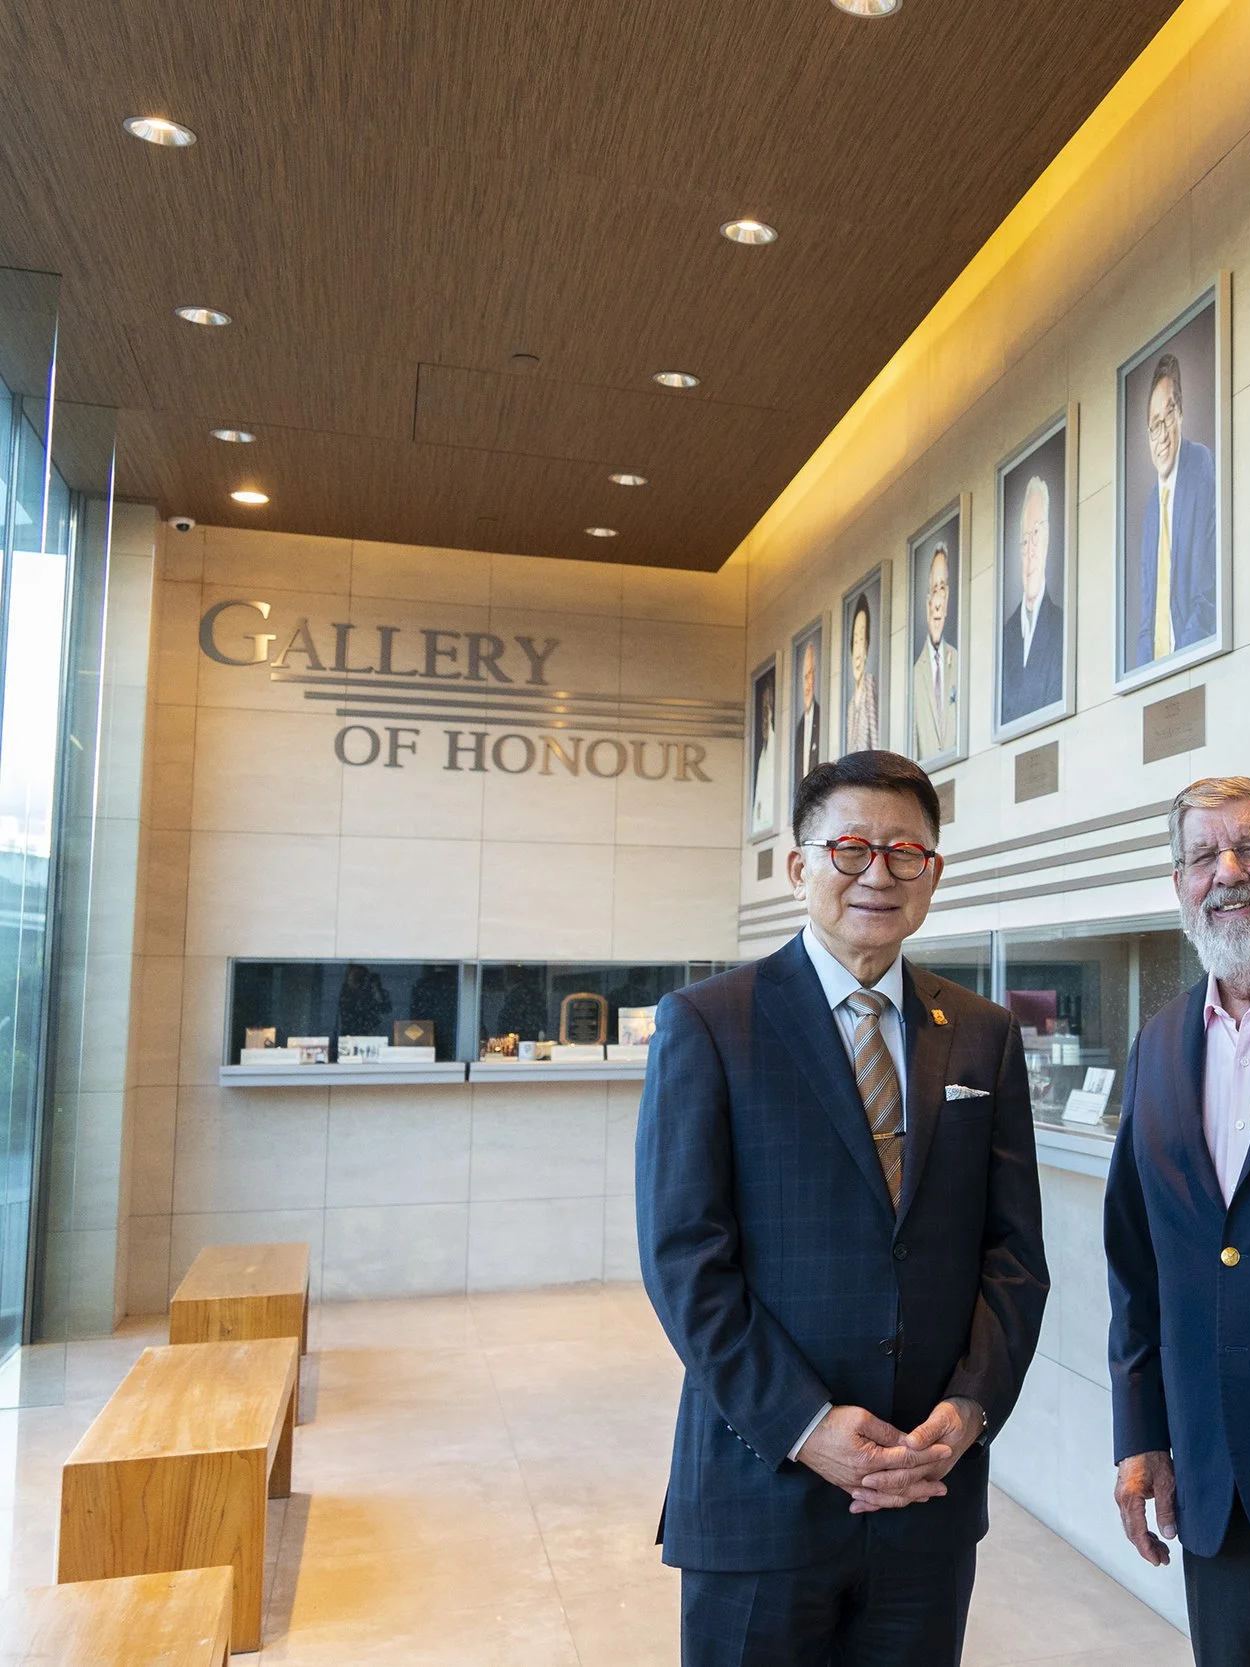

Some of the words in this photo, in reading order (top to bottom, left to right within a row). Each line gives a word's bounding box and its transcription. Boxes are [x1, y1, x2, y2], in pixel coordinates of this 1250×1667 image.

[199, 600, 560, 686] GALLERY
[334, 724, 420, 769] OF
[443, 730, 714, 784] HONOUR
